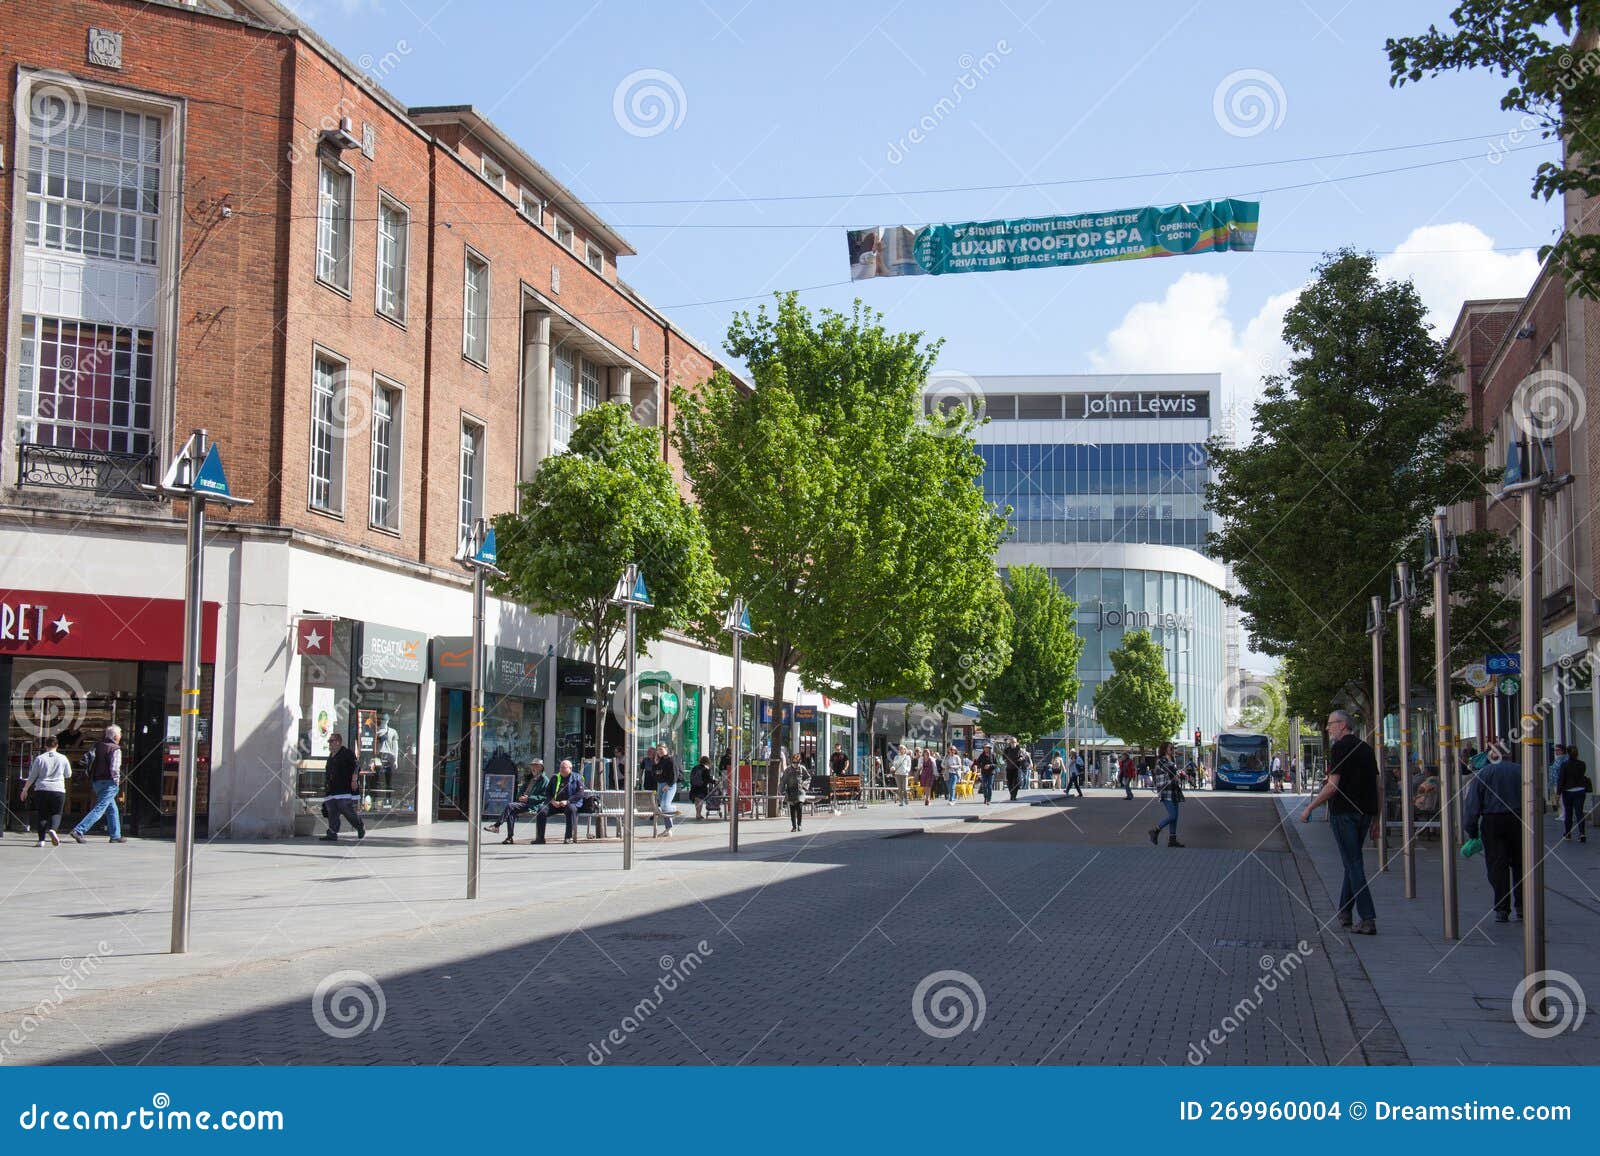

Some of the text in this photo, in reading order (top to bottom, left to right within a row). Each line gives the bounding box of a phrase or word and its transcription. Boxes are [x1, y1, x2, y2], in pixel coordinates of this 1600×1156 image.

[954, 228, 966, 238] ST
[1051, 218, 1094, 231] LEISURE
[1095, 214, 1138, 227] CENTRE
[1160, 222, 1198, 232] OPENING
[1167, 231, 1192, 241] SOON
[951, 239, 1018, 256] LUXURY
[1104, 228, 1143, 245] SPA
[949, 258, 988, 267] PRIVATE
[1057, 247, 1118, 260] RELAXATION
[1119, 244, 1146, 254] AREA
[1082, 393, 1196, 418] John Lewis
[1096, 600, 1150, 632] John
